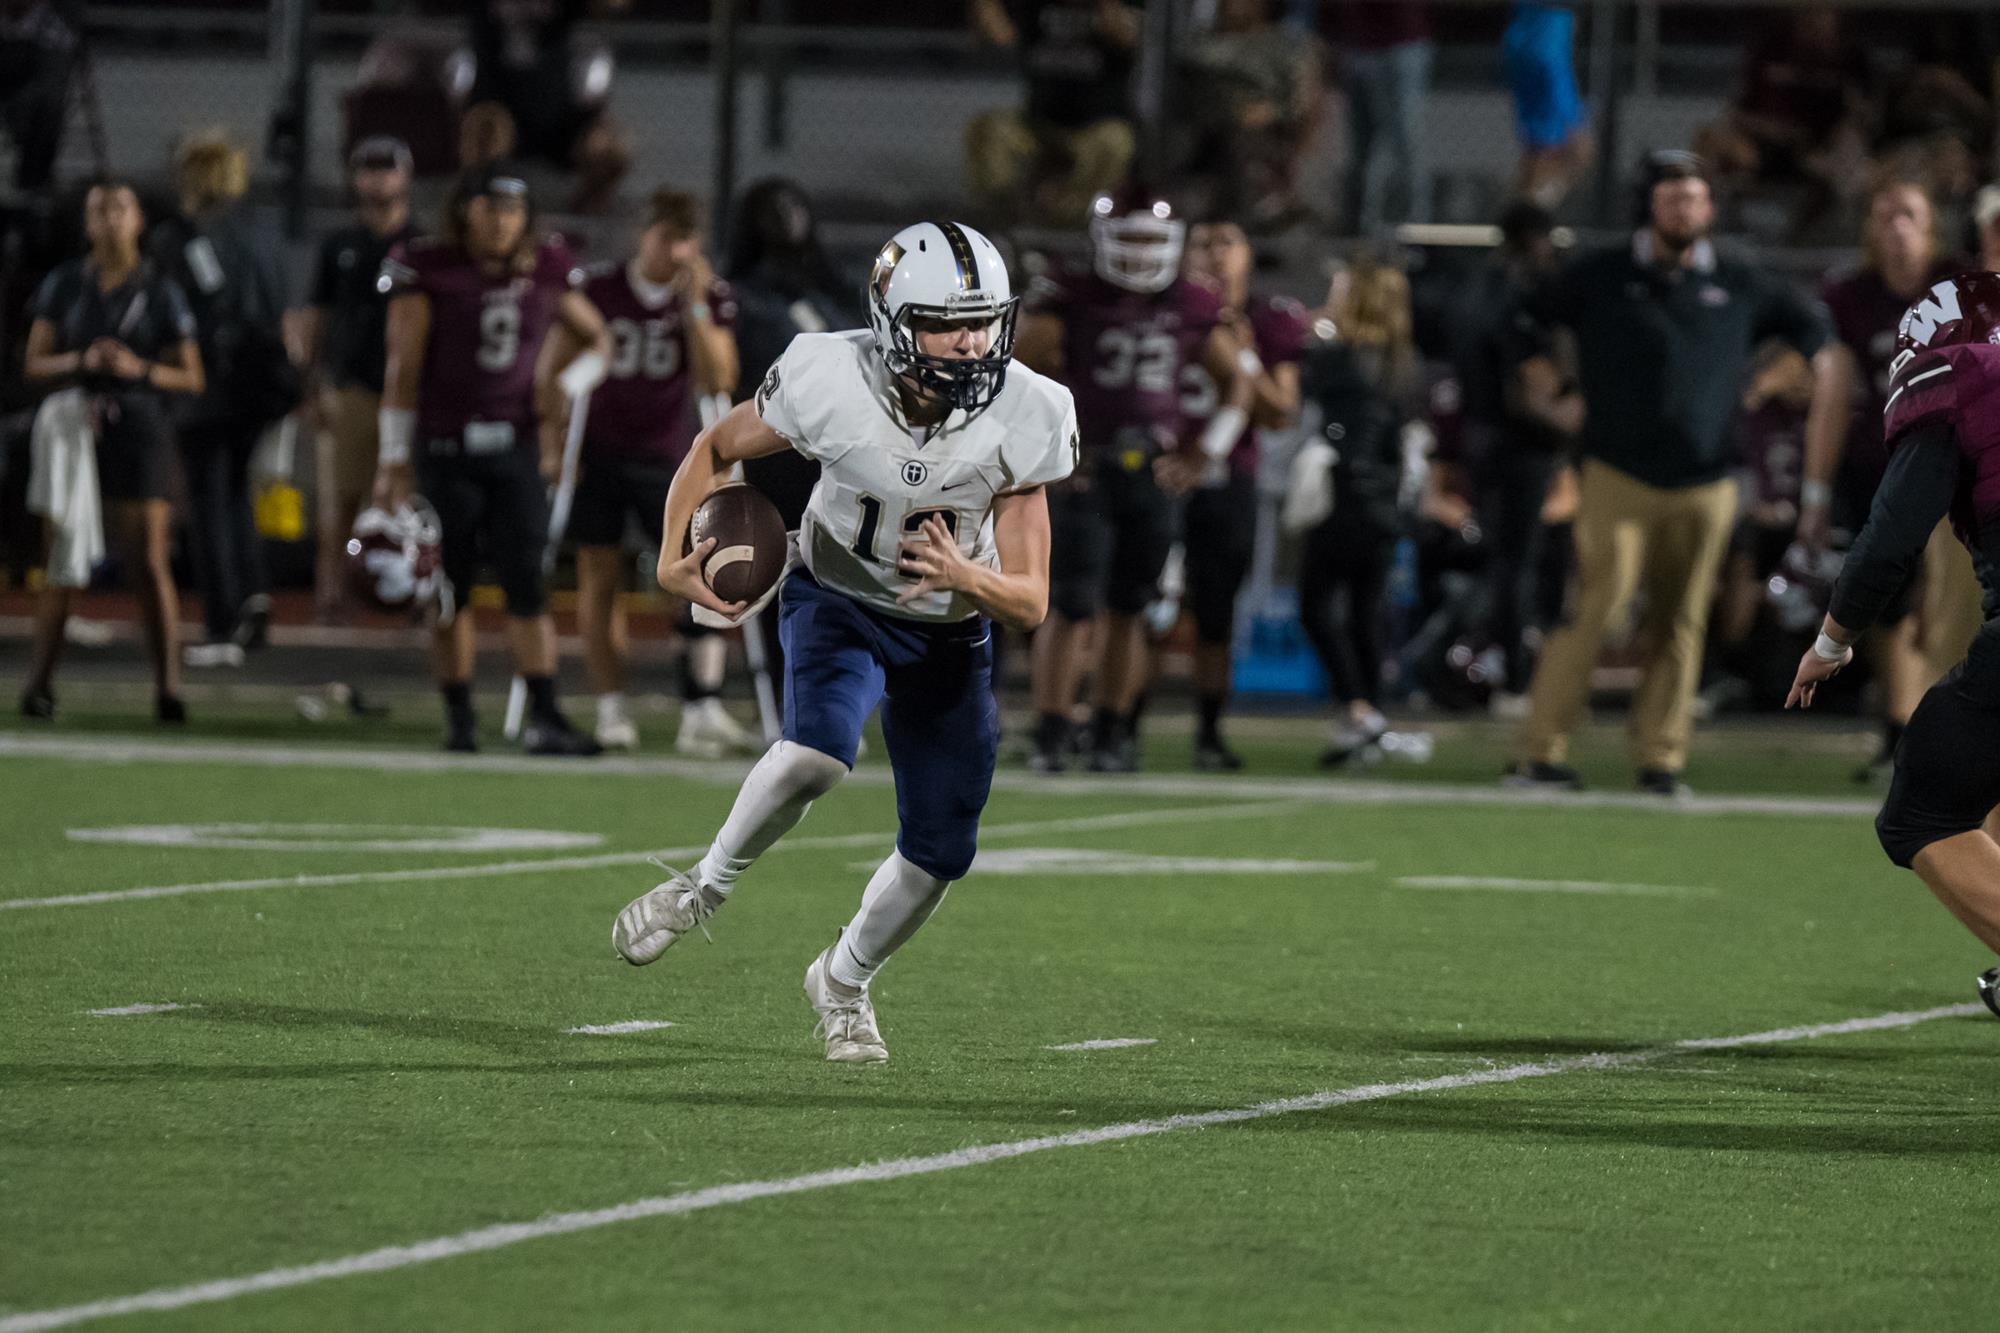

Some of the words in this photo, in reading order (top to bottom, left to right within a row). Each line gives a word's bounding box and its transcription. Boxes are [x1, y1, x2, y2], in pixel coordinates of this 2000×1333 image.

[479, 302, 522, 371] 9
[1899, 280, 1963, 346] W
[1096, 329, 1178, 392] 32
